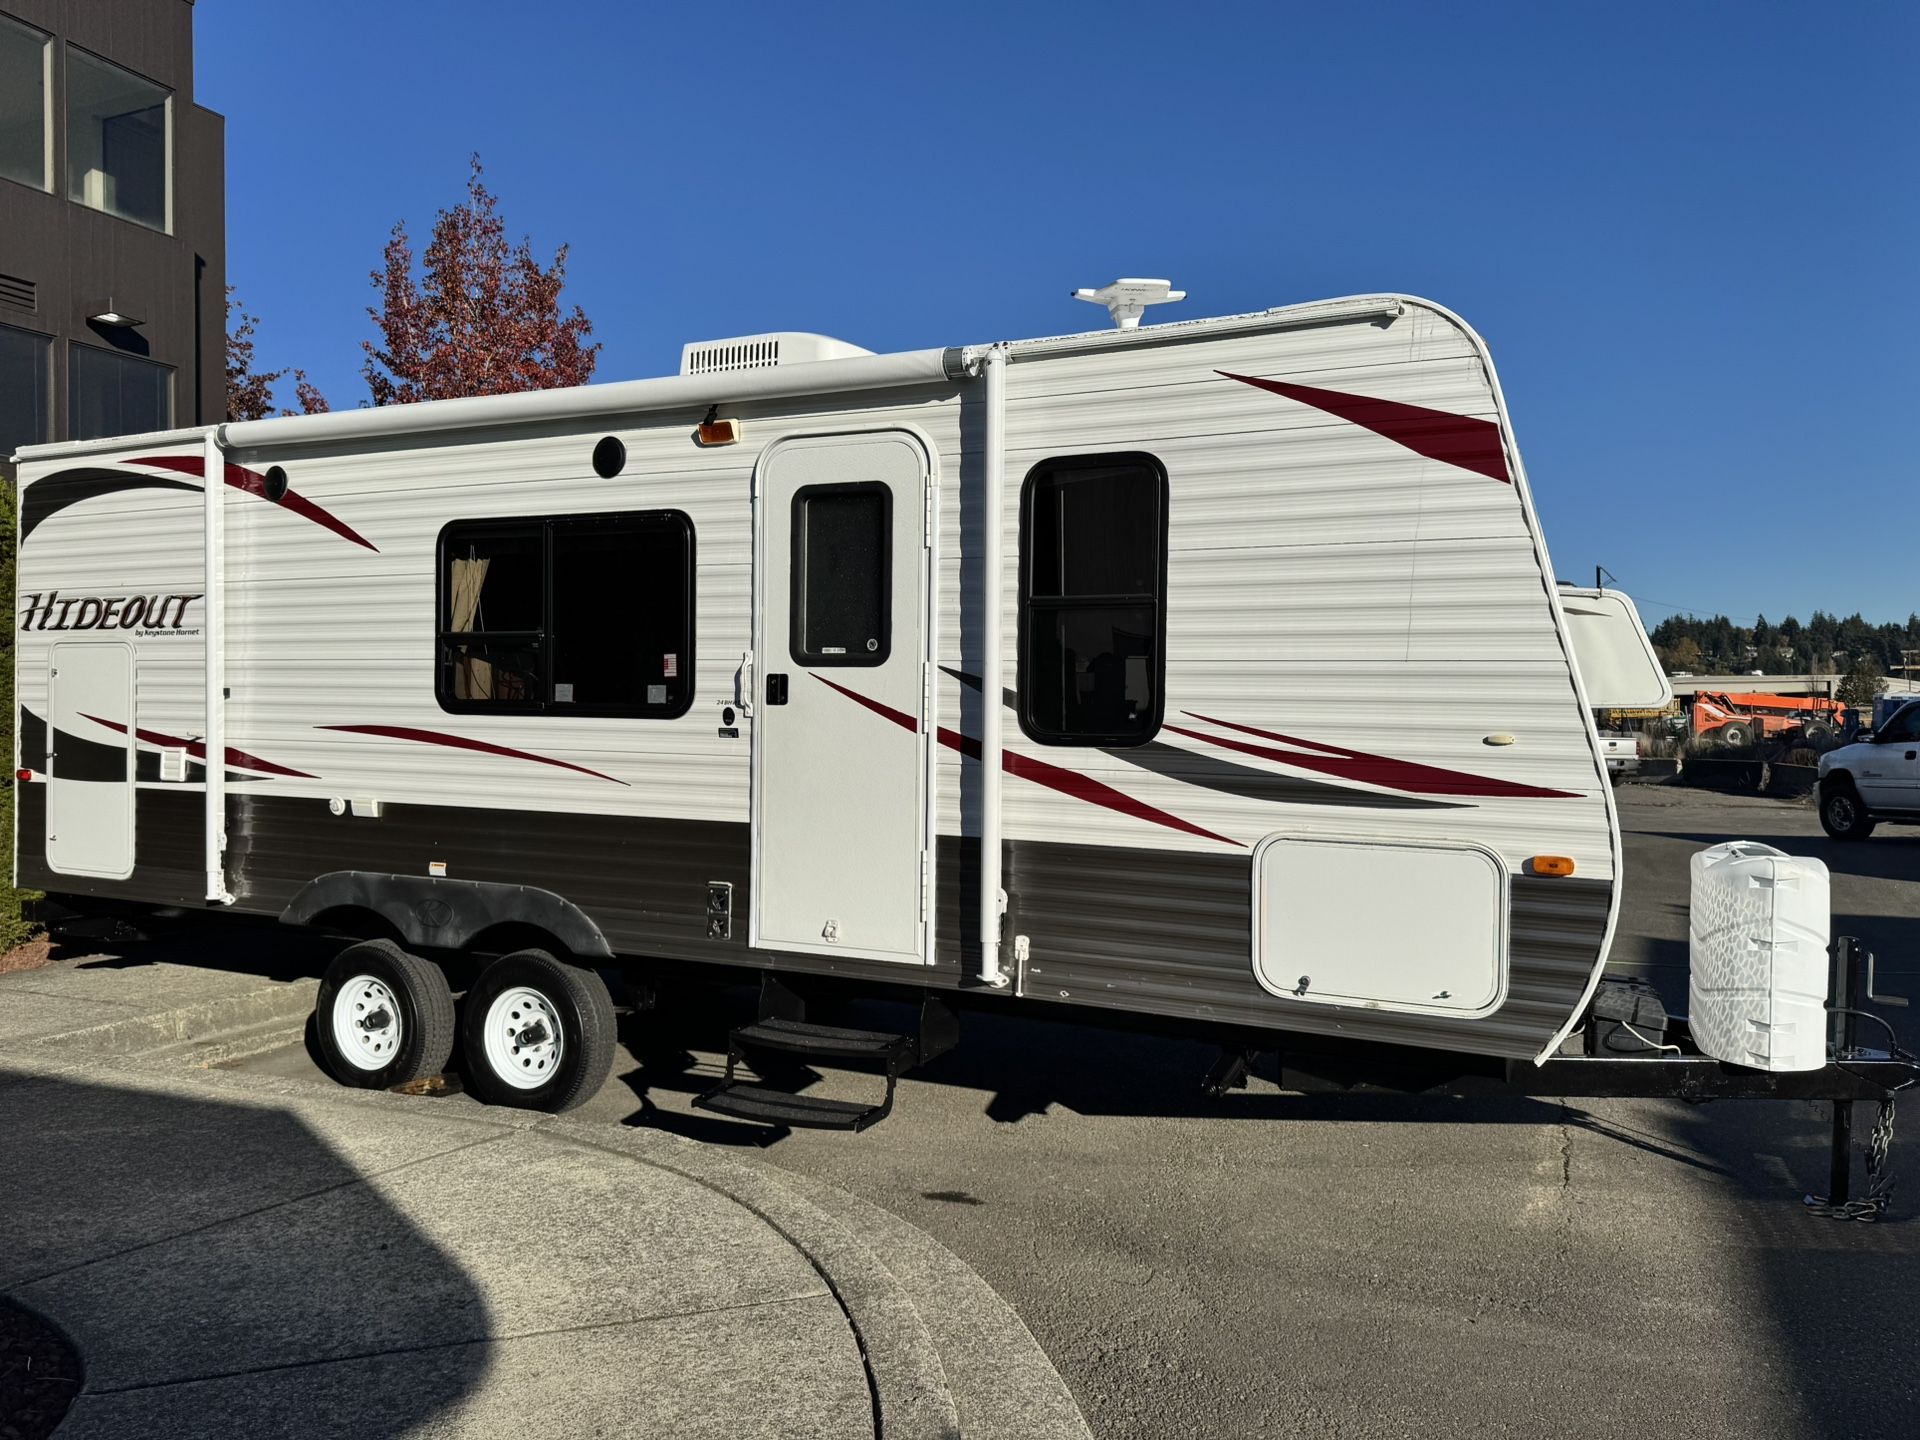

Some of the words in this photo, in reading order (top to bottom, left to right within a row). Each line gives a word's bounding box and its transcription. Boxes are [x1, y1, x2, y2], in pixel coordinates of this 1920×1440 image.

[20, 591, 204, 631] HIDEOUT
[135, 629, 144, 637] by
[144, 629, 175, 637] Keystone
[176, 628, 200, 636] Hornet
